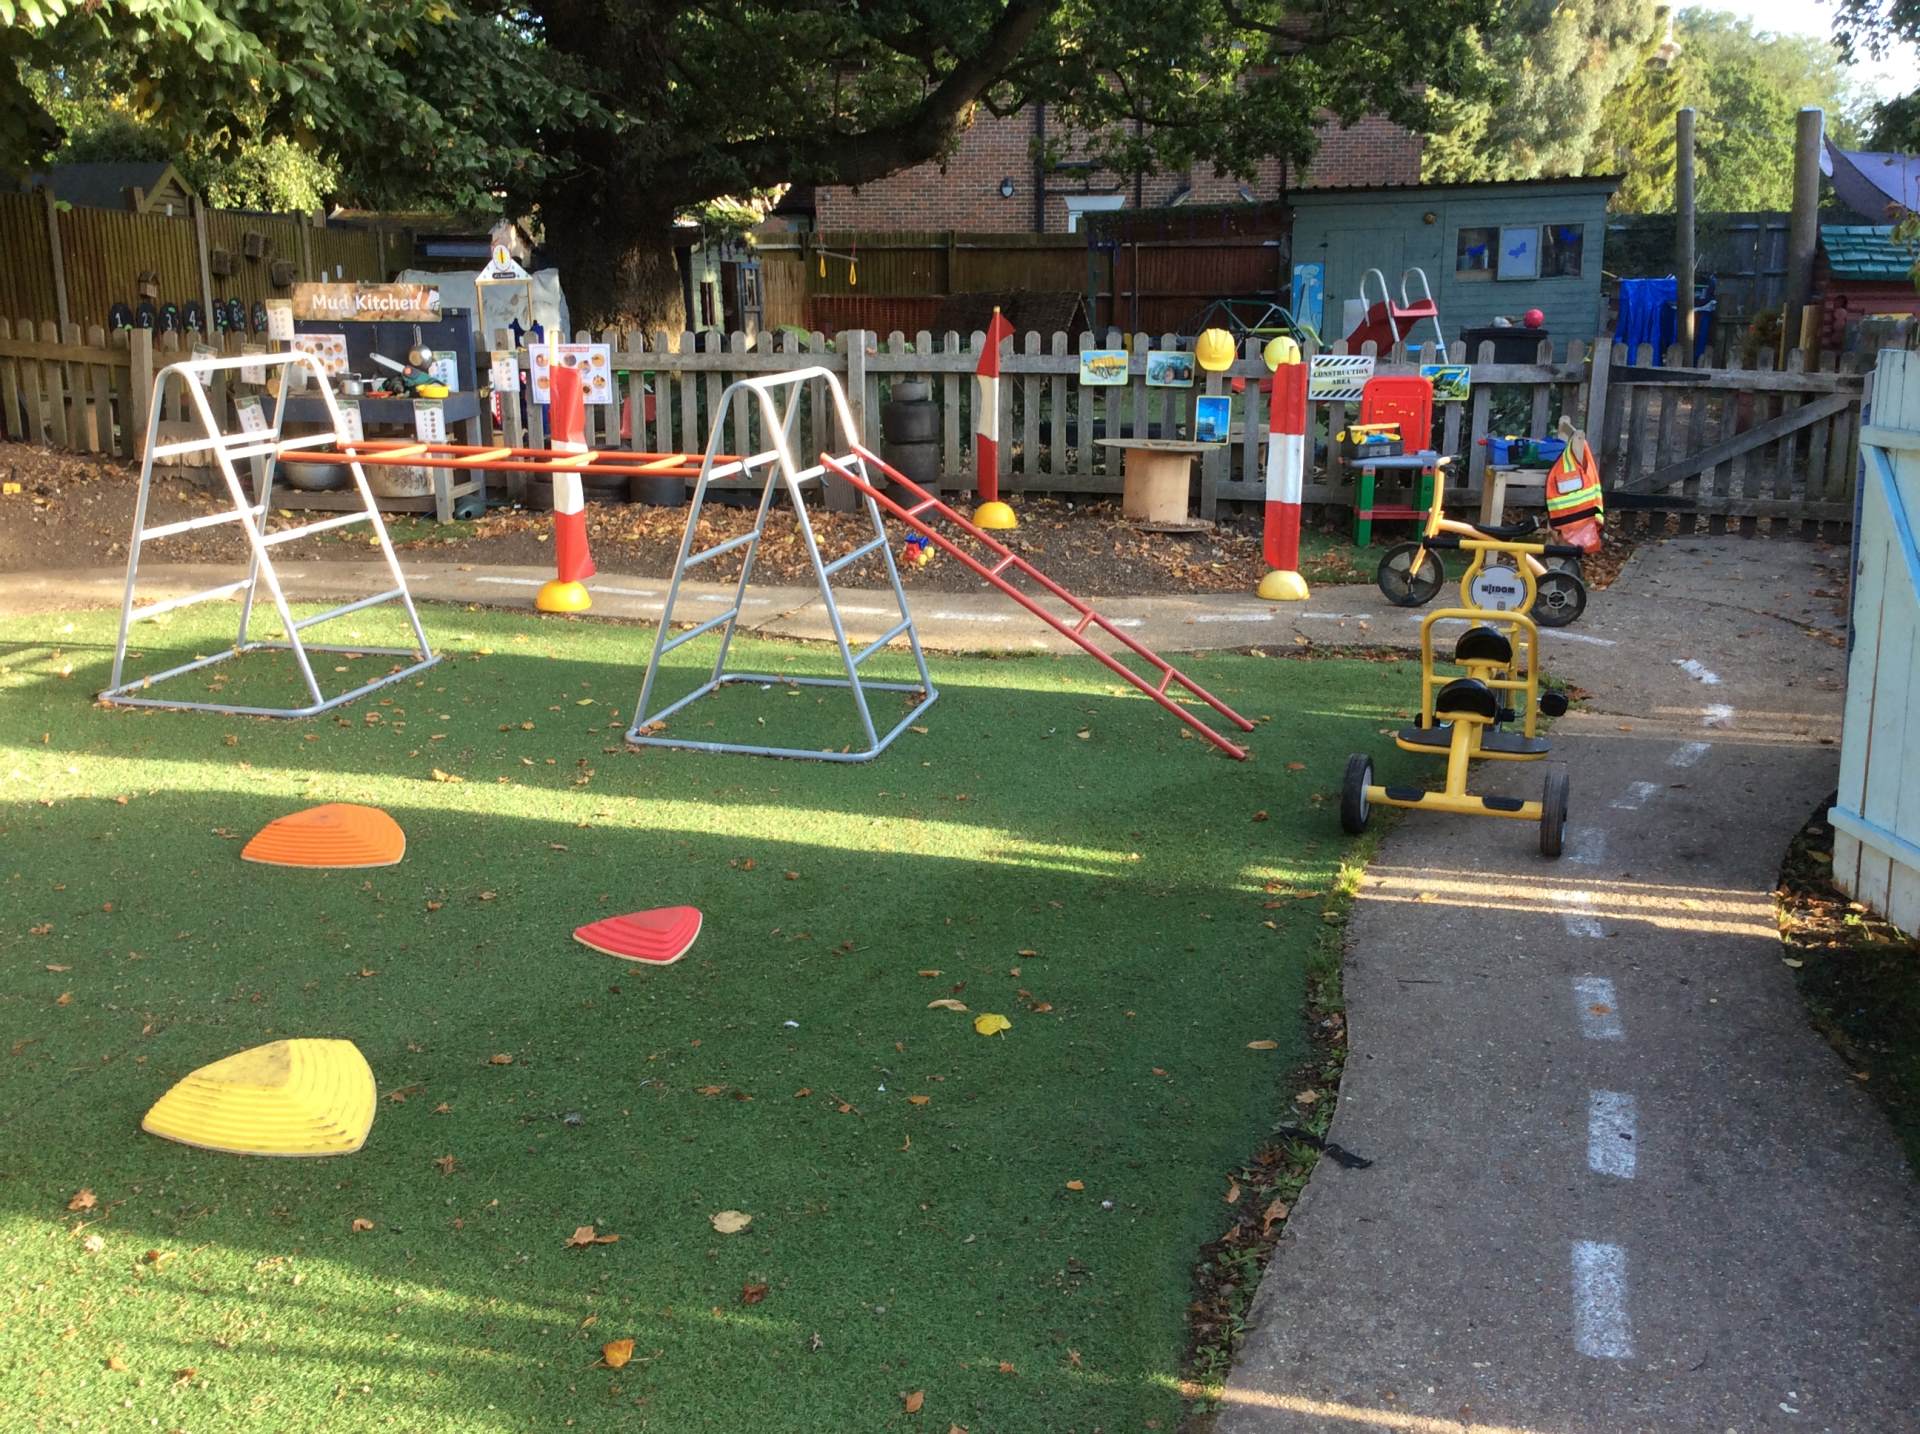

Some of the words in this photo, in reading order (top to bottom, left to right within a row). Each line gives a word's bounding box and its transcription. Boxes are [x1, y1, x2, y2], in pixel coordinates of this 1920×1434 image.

[312, 294, 349, 310] Mud
[355, 293, 420, 311] Kitchen
[115, 312, 123, 327] 1
[142, 312, 149, 327] 2
[166, 313, 173, 331] 3
[189, 310, 197, 327] 4
[216, 309, 222, 323] 5
[1314, 368, 1369, 377] CONSTRUCTION
